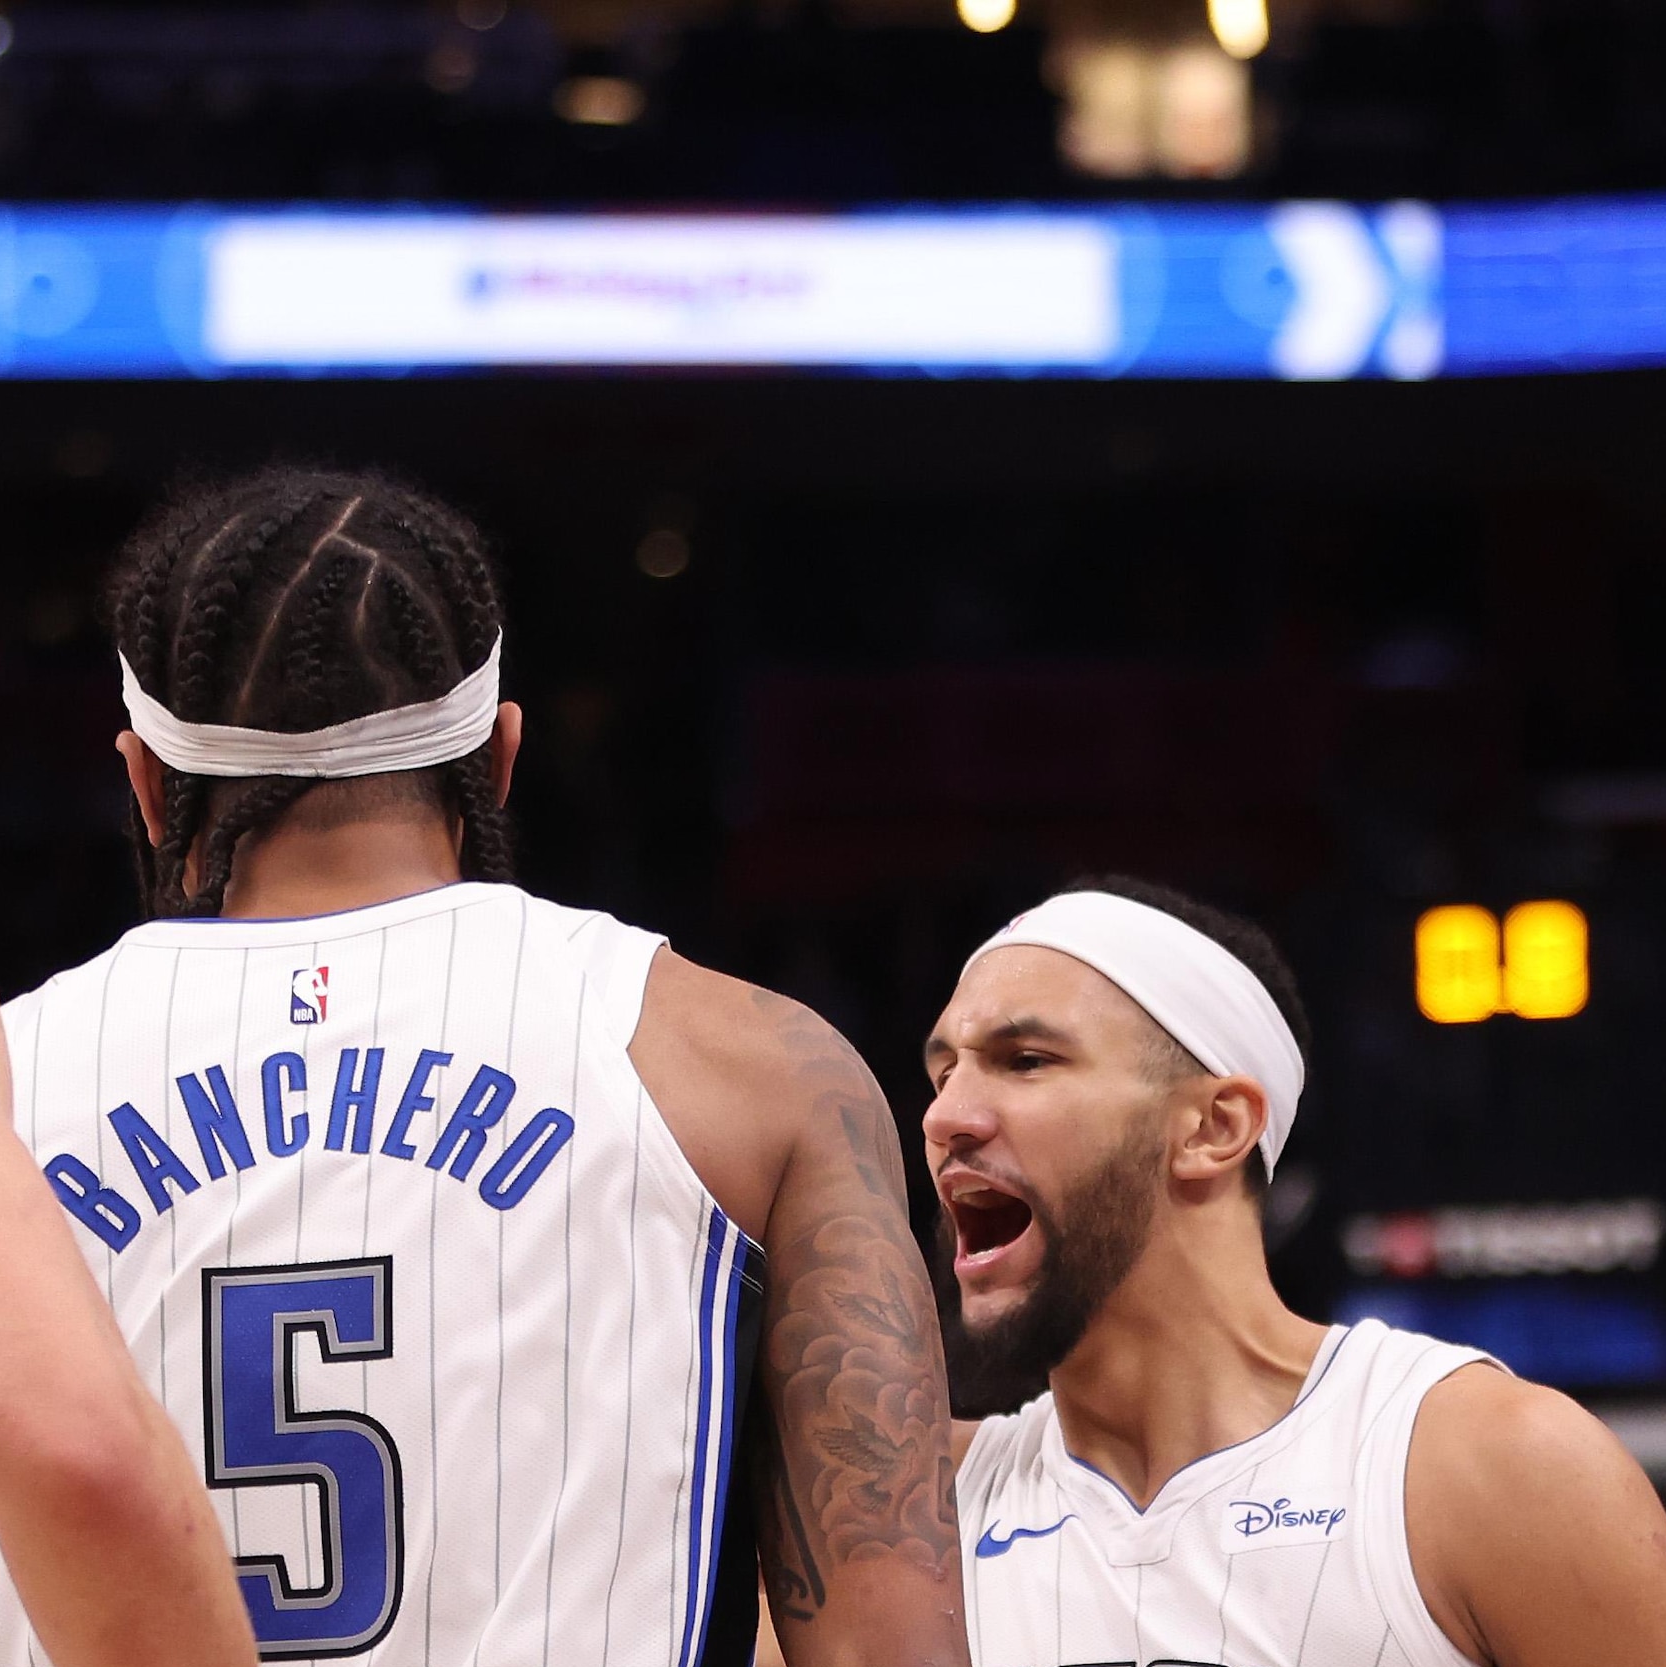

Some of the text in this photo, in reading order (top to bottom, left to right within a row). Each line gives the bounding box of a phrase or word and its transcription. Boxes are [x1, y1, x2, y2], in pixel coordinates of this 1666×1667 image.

[293, 1007, 314, 1022] NBA
[43, 1047, 575, 1254] BANCHERO
[201, 1255, 405, 1662] 5
